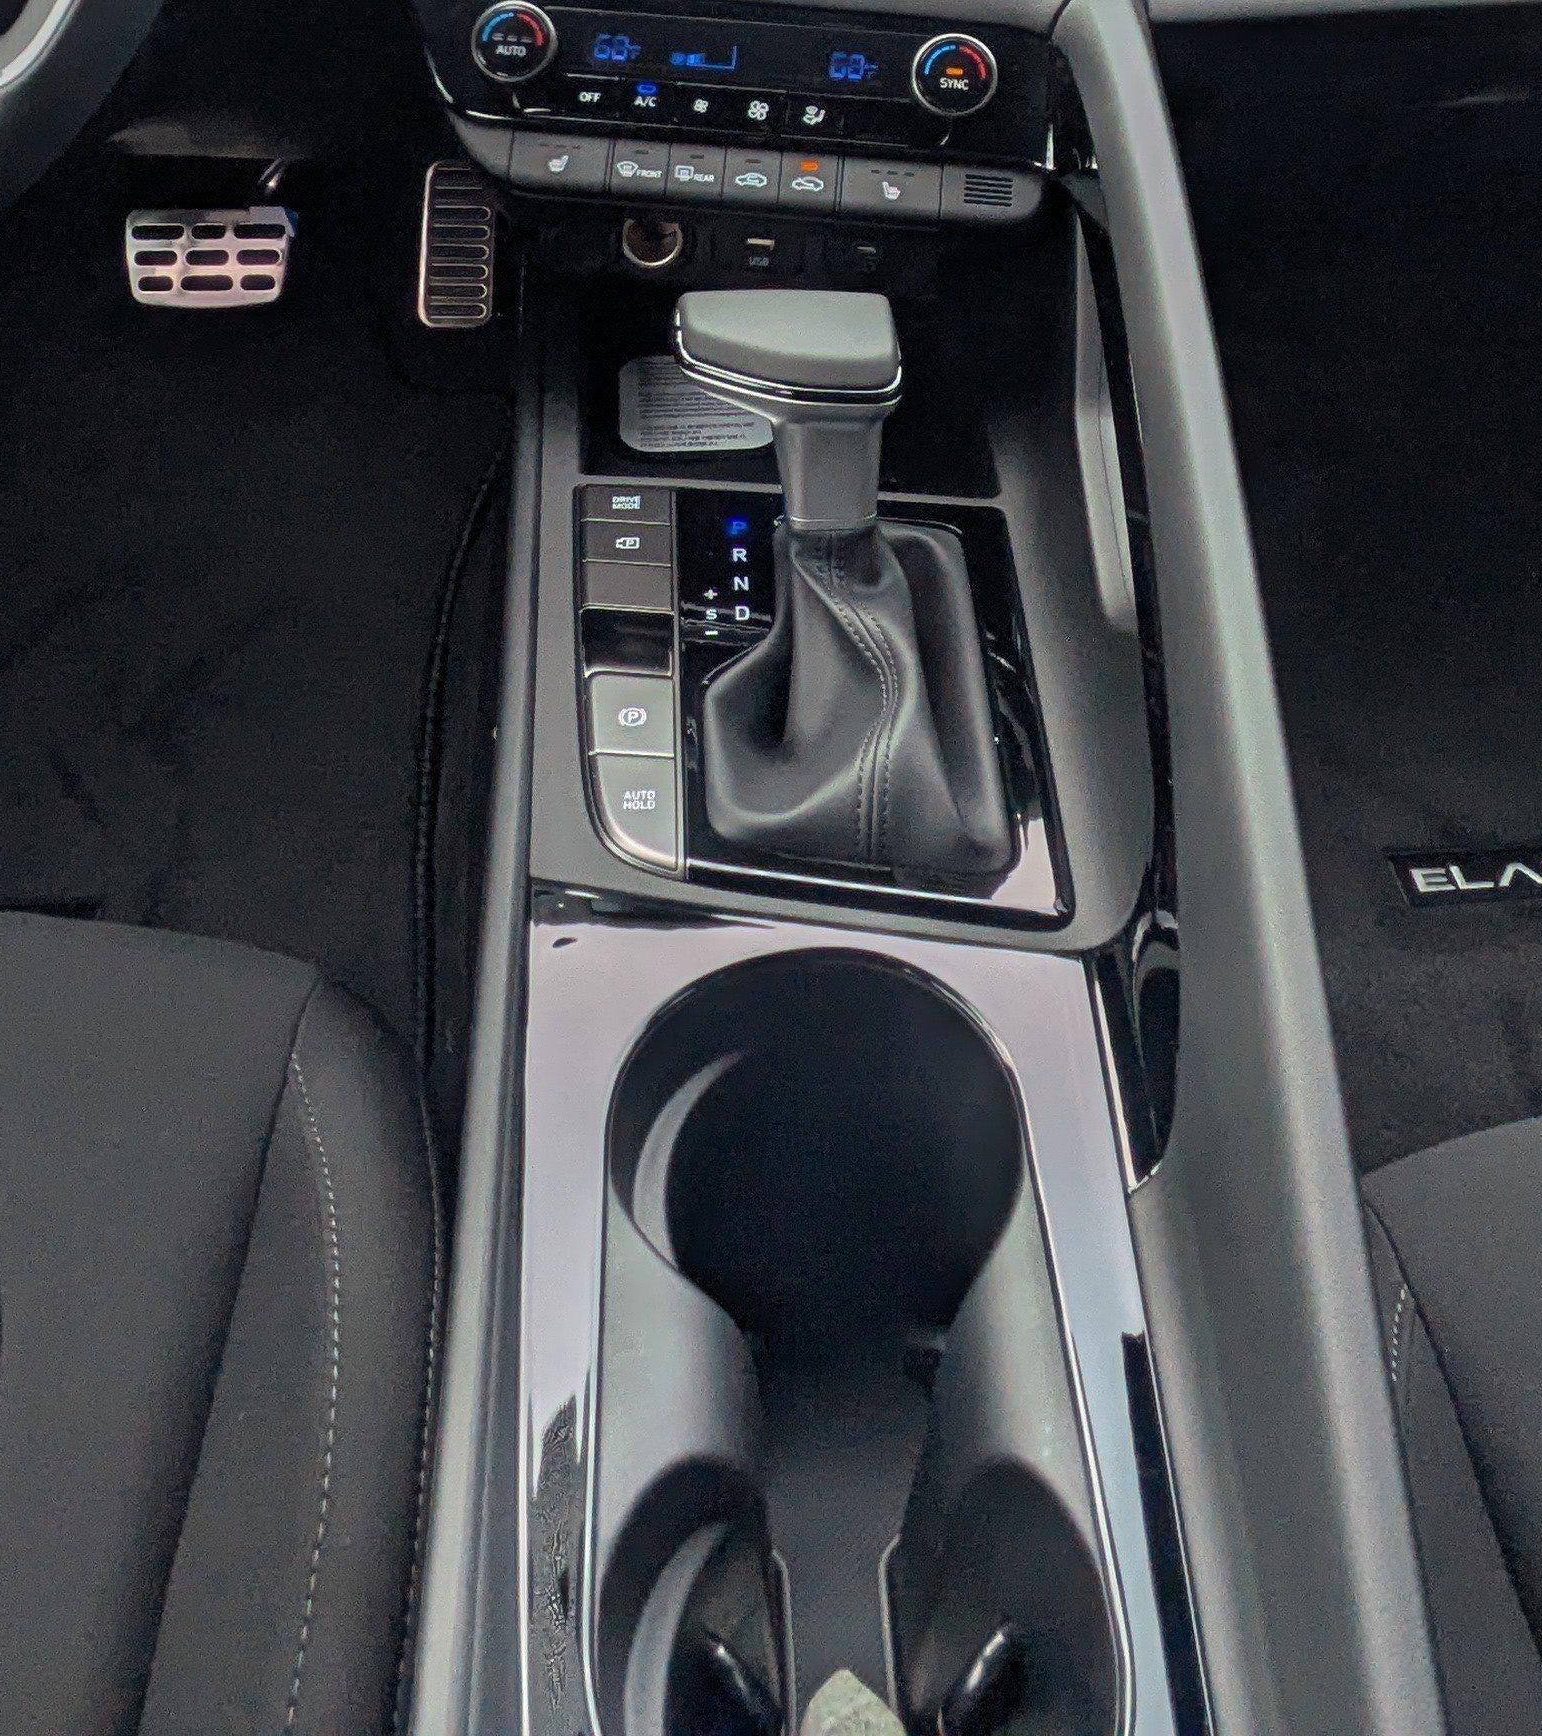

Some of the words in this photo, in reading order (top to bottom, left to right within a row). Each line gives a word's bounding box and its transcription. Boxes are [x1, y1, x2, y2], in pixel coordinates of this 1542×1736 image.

[495, 44, 527, 57] AUTO
[939, 77, 970, 92] SYNC
[578, 91, 602, 103] OFF
[633, 96, 658, 108] A/C
[636, 169, 663, 179] FRONT
[693, 172, 715, 183] REAR
[612, 495, 642, 503] DRIVE
[612, 502, 641, 510] MODE
[732, 520, 747, 535] P
[732, 548, 748, 563] R
[733, 575, 750, 592] N
[705, 608, 718, 621] S
[734, 605, 751, 622] D
[623, 790, 656, 800] AUTO
[623, 799, 656, 810] HOLD
